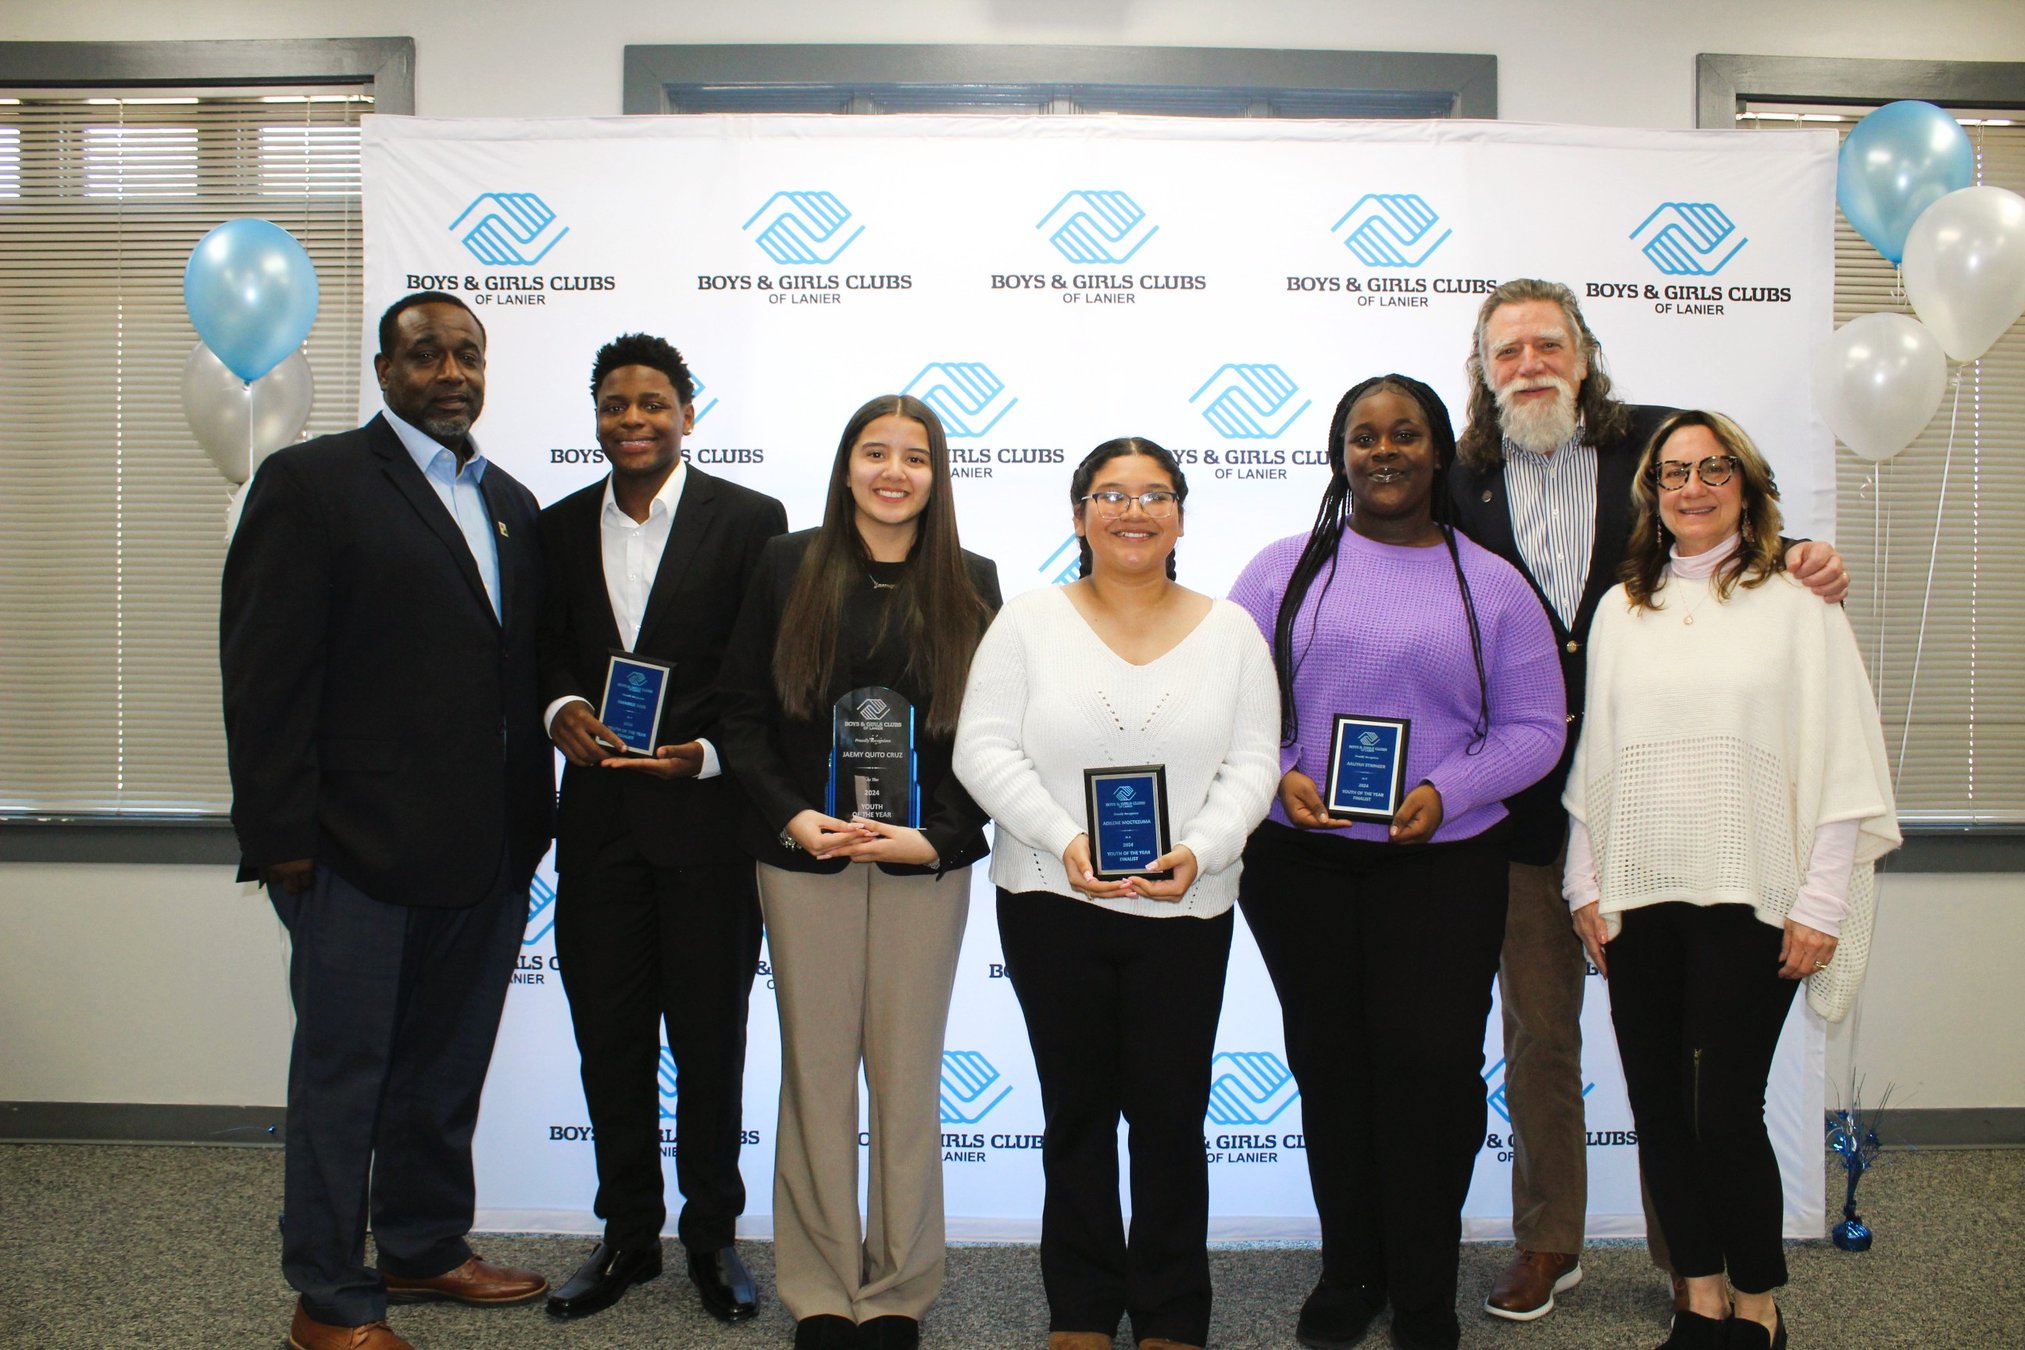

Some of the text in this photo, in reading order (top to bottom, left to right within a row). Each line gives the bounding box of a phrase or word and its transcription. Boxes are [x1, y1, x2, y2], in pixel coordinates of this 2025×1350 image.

[406, 274, 616, 291] BOYS & GIRLS CLUBS
[697, 275, 913, 290] BOYS & GIRLS CLUBS
[991, 274, 1207, 290] BOYS & GIRLS CLUBS
[1286, 276, 1497, 294] BOYS & GIRLS CLUBS
[474, 294, 546, 306] OF LANIER
[768, 293, 841, 305] OF LANIER
[1062, 292, 1136, 304] OF LANIER
[1585, 282, 1792, 303] BOYS & GIRLS CLUBS
[1357, 295, 1429, 308] OF LANIER
[1654, 302, 1725, 316] OF LANIER
[550, 448, 605, 464] BOYS
[697, 448, 764, 464] CLUBS
[948, 448, 1065, 464] IRLS CLUBS
[1173, 449, 1330, 465] YS & GIRLS CLU
[950, 467, 993, 478] ANIER
[1214, 468, 1288, 480] OF LANIER
[511, 973, 545, 985] NIER
[549, 1126, 593, 1141] BOY
[941, 1133, 1045, 1149] IRLS CLUB
[1486, 1133, 1503, 1149] &
[1586, 1131, 1638, 1146] LUBS
[1215, 1134, 1278, 1149] GIRLS
[943, 1151, 987, 1163] ANIER
[1207, 1152, 1278, 1164] OF LANIER
